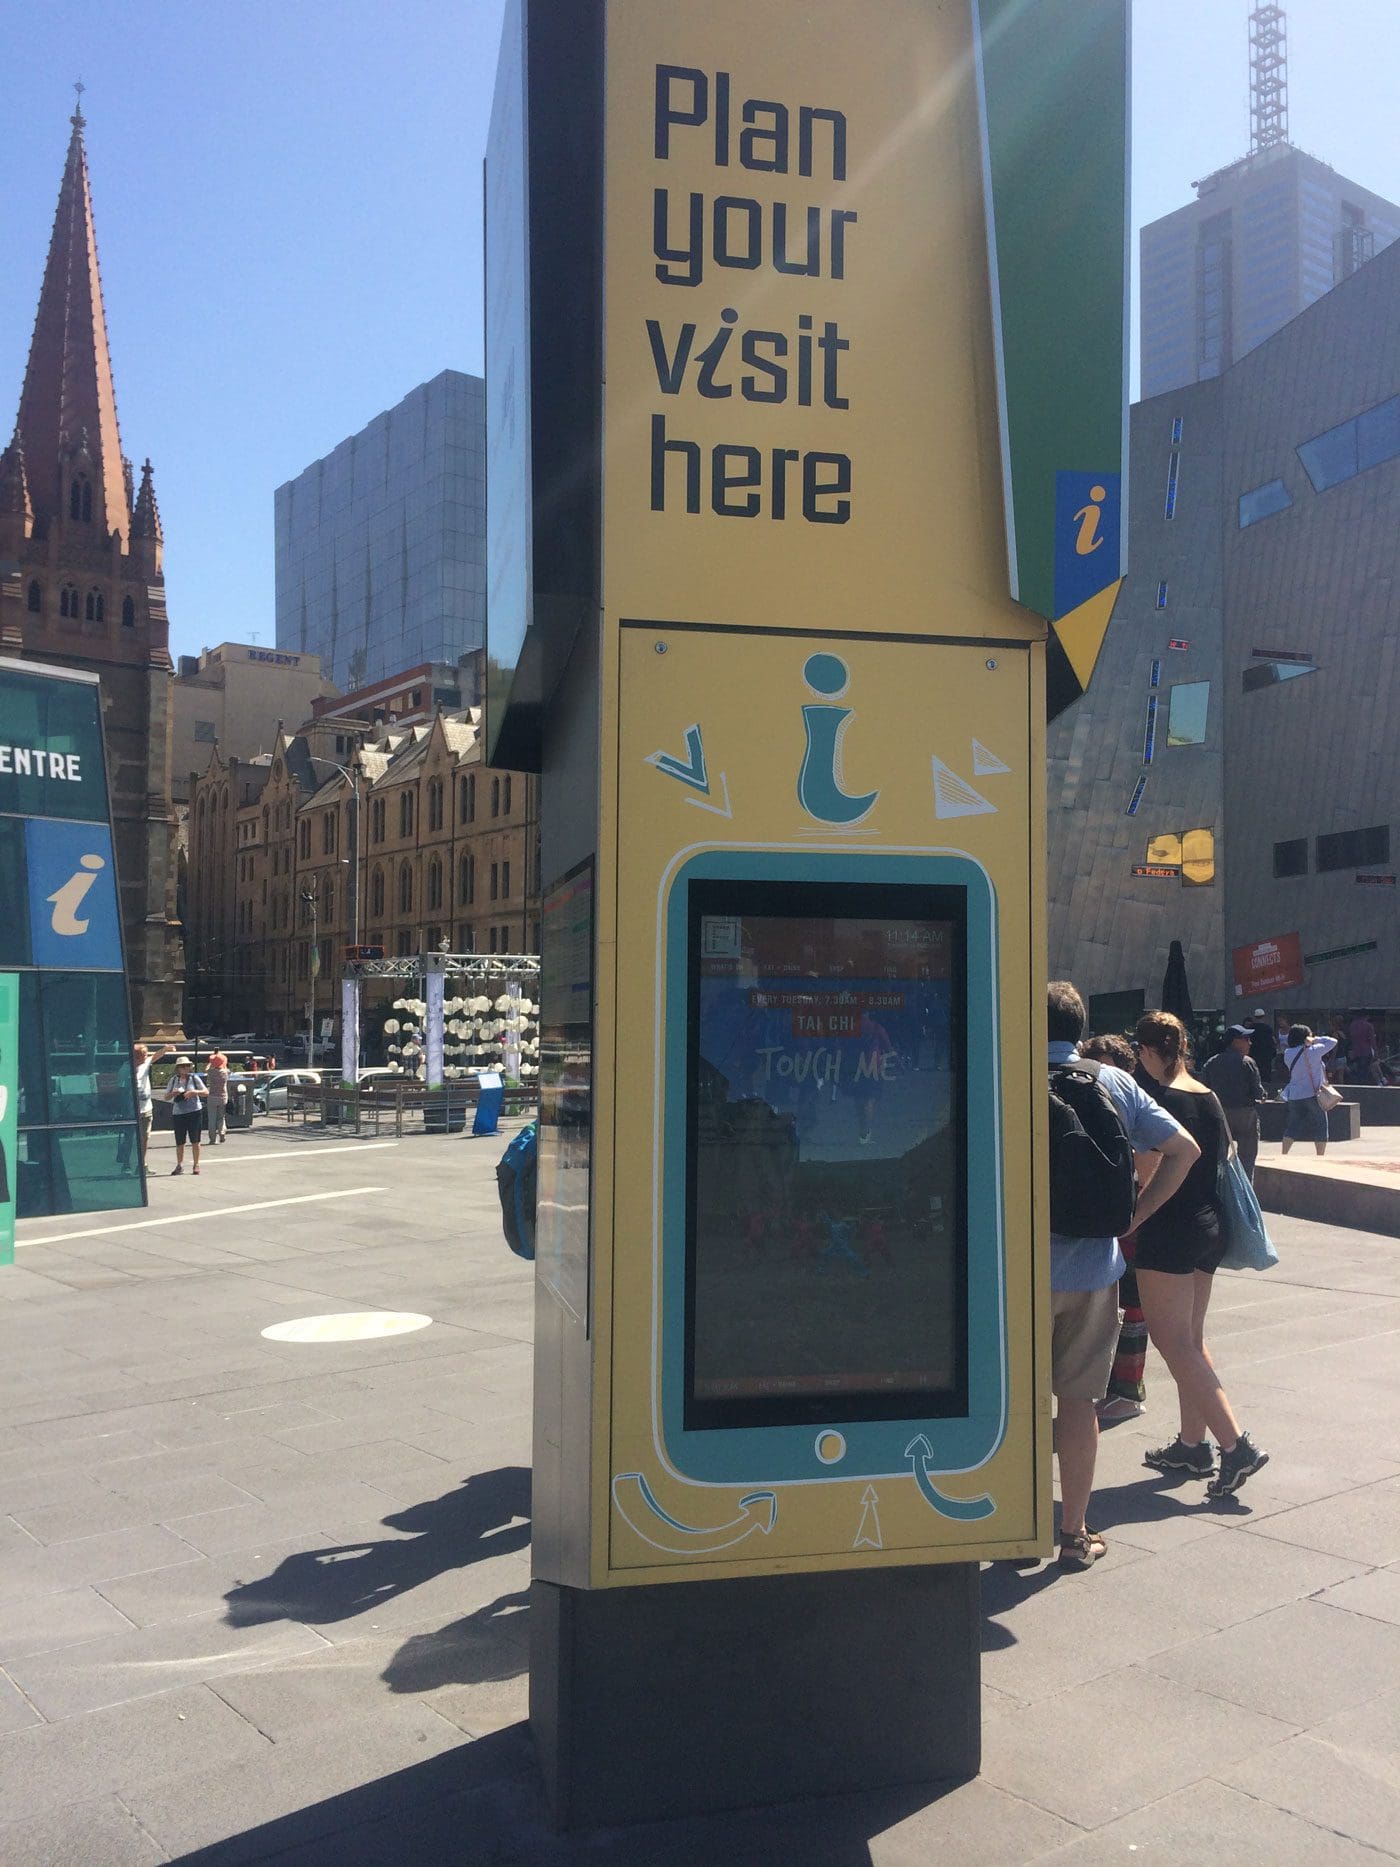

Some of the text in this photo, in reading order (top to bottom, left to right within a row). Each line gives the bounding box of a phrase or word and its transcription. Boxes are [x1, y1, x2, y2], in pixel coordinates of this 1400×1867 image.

[654, 63, 847, 182] Plan
[653, 188, 858, 288] your
[645, 307, 850, 410] visit
[650, 413, 852, 525] here
[248, 650, 301, 667] REGENT
[0, 744, 82, 782] ENTRE
[797, 1015, 855, 1031] TAI CHI
[755, 1046, 898, 1083] TOUCH ME
